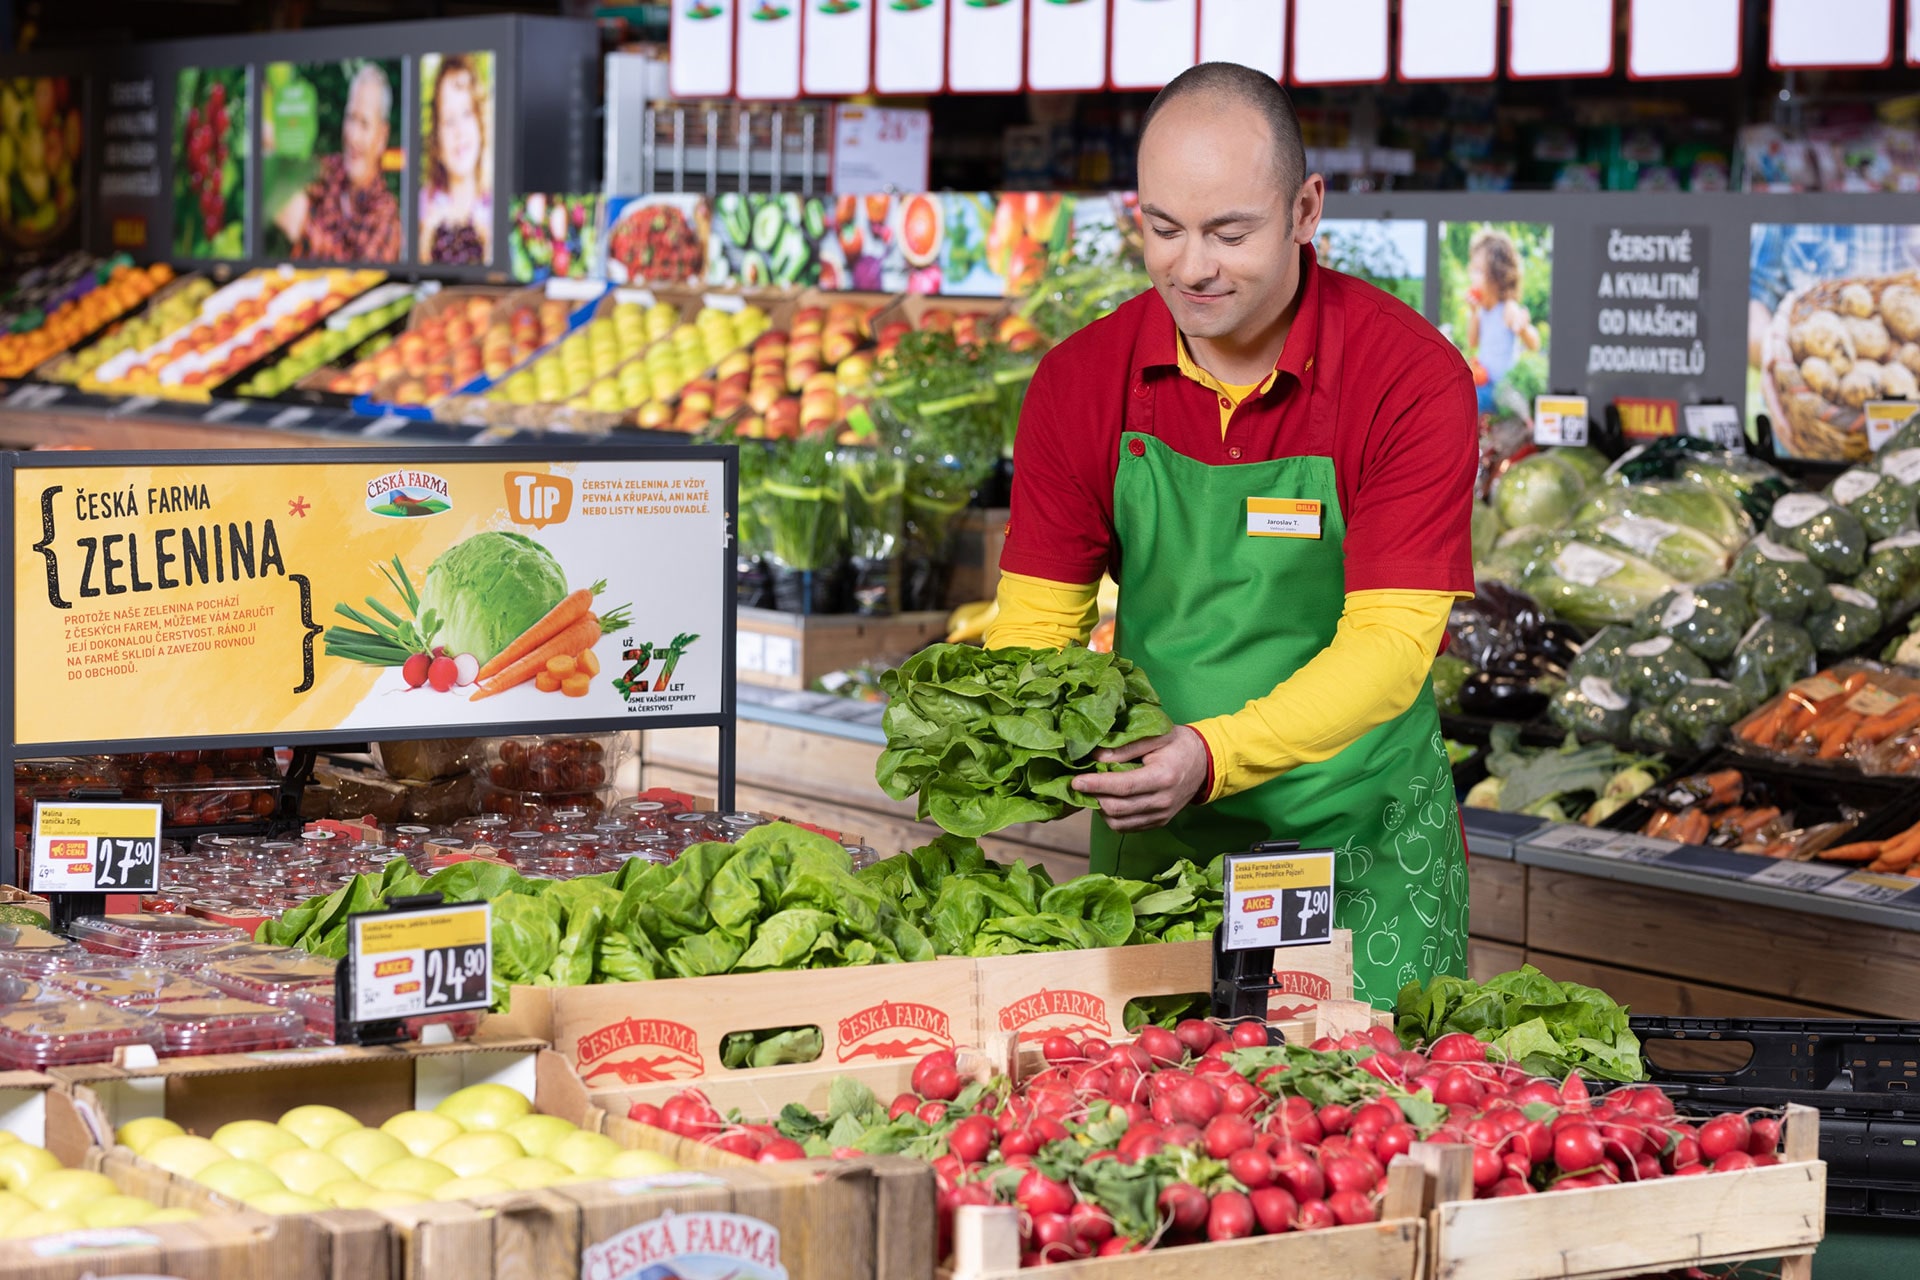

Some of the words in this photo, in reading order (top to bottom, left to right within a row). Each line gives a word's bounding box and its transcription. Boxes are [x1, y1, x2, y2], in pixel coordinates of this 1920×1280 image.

[1607, 229, 1692, 263] ČERSTVÉ
[1598, 272, 1614, 298] A
[1615, 266, 1700, 300] KVALITNÍ
[1599, 309, 1625, 335] OD
[1627, 304, 1698, 337] NAŠICH
[1588, 339, 1706, 375] DODAVATELŮ
[368, 469, 406, 498] ČESKÁ
[408, 472, 448, 497] FARMA
[582, 479, 623, 490] ČERSTVÁ
[625, 480, 669, 489] ZELENINA
[671, 480, 681, 489] JE
[684, 477, 706, 488] VŽDY
[582, 492, 613, 503] PEVNÁ
[614, 493, 621, 502] A
[623, 491, 667, 503] KŘUPAVÁ,
[669, 492, 684, 501] ANI
[686, 490, 709, 501] NATĚ
[76, 484, 139, 521] ČESKÁ
[148, 484, 211, 515] FARMA
[582, 507, 607, 515] NEBO
[609, 506, 634, 515] LISTY
[637, 506, 671, 514] NEJSOU
[673, 503, 710, 514] OVADLÉ.
[77, 519, 286, 597] ZELENINA
[64, 611, 111, 626] PROTOŽE
[114, 606, 141, 621] NAŠE
[143, 602, 193, 617] ZELENINA
[196, 595, 240, 611] POCHÁZÍ
[65, 630, 71, 640] Z
[74, 622, 121, 639] ČESKÝCH
[124, 619, 162, 633] FAREM,
[164, 612, 208, 628] MŮŽEME
[210, 609, 231, 623] VÁM
[233, 605, 276, 620] ZARUČIT
[66, 640, 88, 654] JEJÍ
[90, 635, 153, 651] DOKONALOU
[155, 627, 215, 644] ČERSTVOST.
[217, 622, 246, 636] RÁNO
[247, 621, 256, 633] JI
[67, 656, 82, 667] NA
[84, 649, 120, 665] FARMĚ
[122, 645, 156, 660] SKLIDÍ
[158, 645, 165, 656] A
[167, 641, 212, 655] ZAVEZOU
[214, 636, 256, 650] ROVNOU
[623, 637, 634, 647] UŽ
[68, 671, 82, 681] DO
[85, 661, 138, 679] OBCHODŮ.
[621, 644, 684, 693] 27
[628, 696, 645, 704] JSME
[646, 694, 667, 703] VAŠIMI
[668, 694, 696, 702] EXPERTY
[669, 683, 685, 692] LET
[638, 704, 673, 712] ČERSTVOST
[66, 818, 81, 826] 125g
[1252, 862, 1268, 871] Farma
[1245, 897, 1271, 910] AKCE
[1283, 974, 1330, 1000] FARMA
[840, 1002, 892, 1045] ČESKÁ
[895, 1006, 948, 1039] FARMA
[1001, 990, 1049, 1031] ČESKÁ
[1053, 992, 1105, 1024] FARMA
[580, 1018, 635, 1062] ČESKÁ
[639, 1022, 698, 1056] FARMA
[588, 1214, 678, 1280] ČESKÁ
[685, 1217, 777, 1269] FARMA
